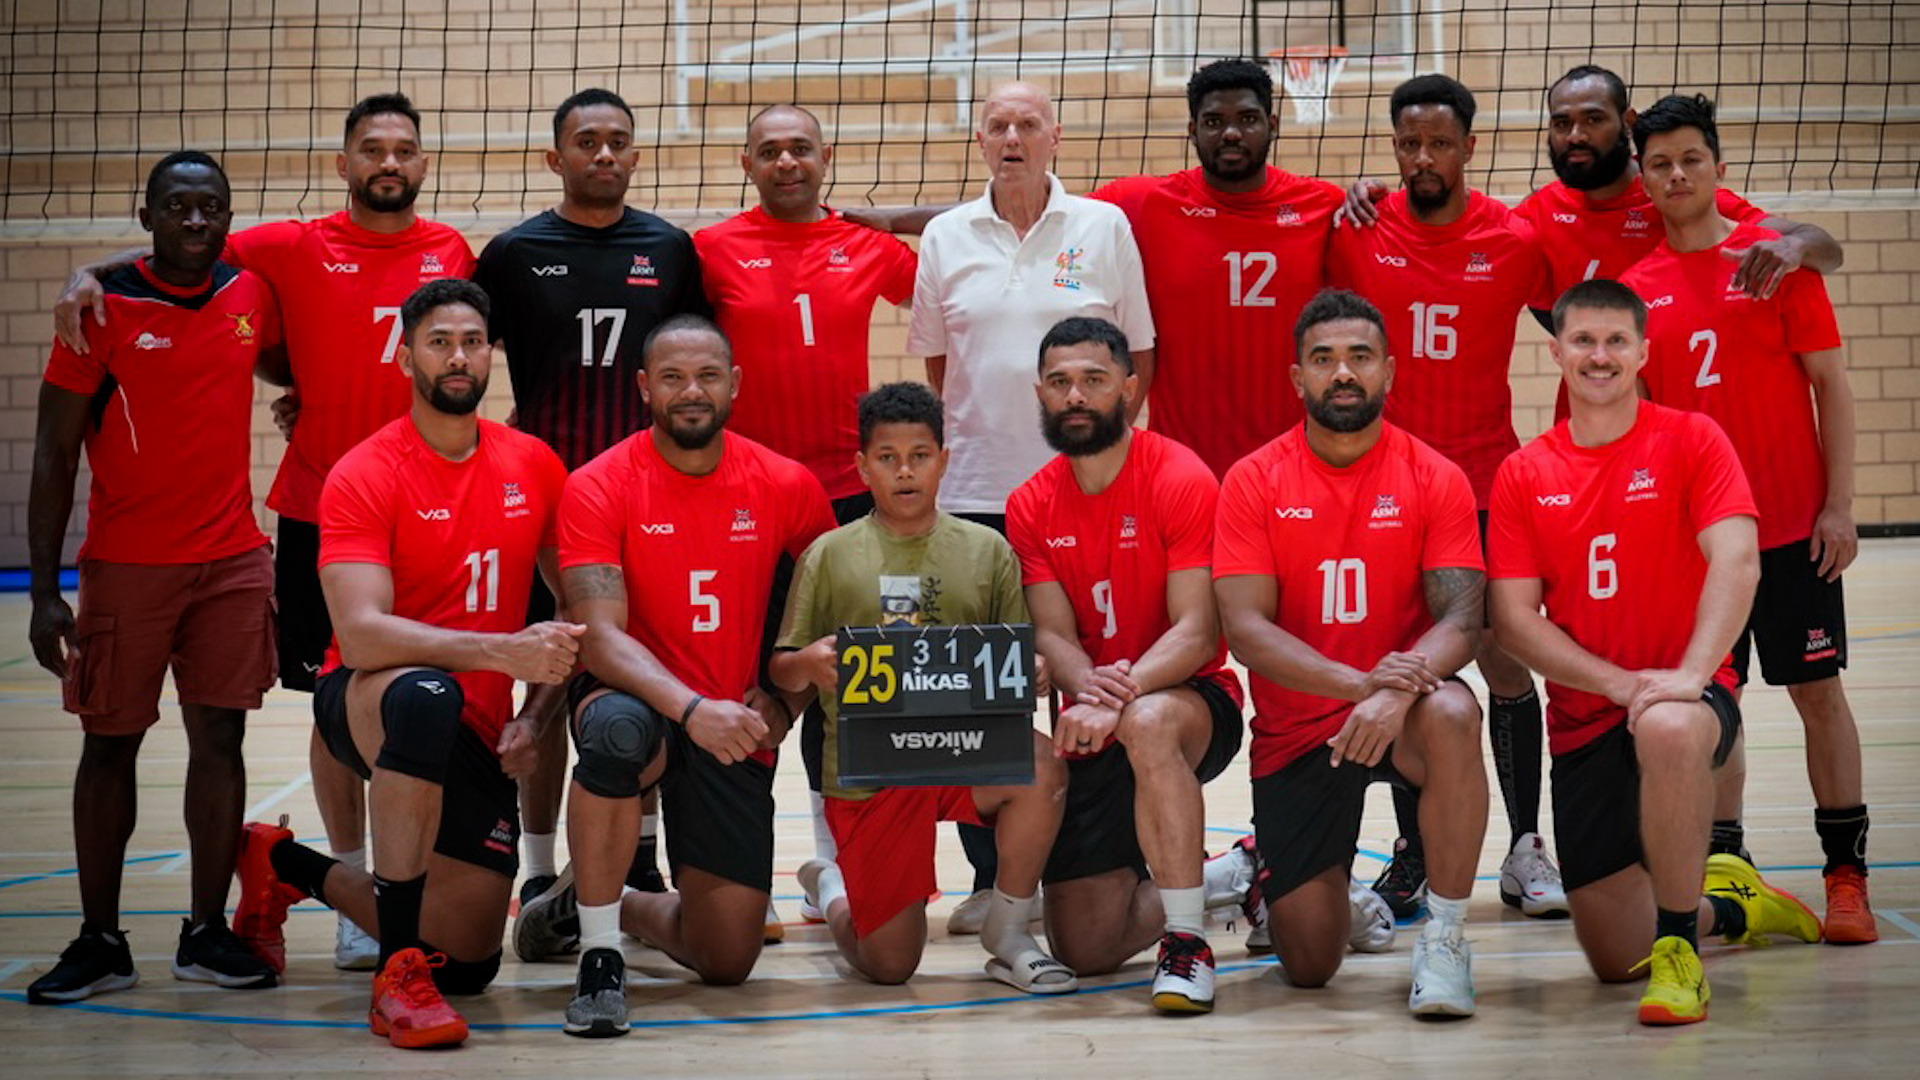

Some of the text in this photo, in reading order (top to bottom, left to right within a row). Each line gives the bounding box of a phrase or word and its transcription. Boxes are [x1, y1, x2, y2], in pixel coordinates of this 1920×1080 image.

[1180, 206, 1217, 218] VX3
[1623, 220, 1650, 230] ARMY
[322, 261, 359, 273] VX3
[737, 258, 773, 269] VX3
[1375, 253, 1407, 268] VX3
[1465, 263, 1494, 273] ARMY
[531, 265, 569, 277] VX3
[630, 266, 656, 277] ARMY
[1222, 252, 1278, 307] 12
[793, 293, 816, 347] 1
[373, 306, 405, 364] 7
[576, 308, 628, 367] 17
[1408, 302, 1460, 360] 16
[1689, 328, 1721, 389] 2
[1626, 477, 1657, 493] ARMY
[1536, 494, 1573, 507] VX3
[416, 508, 451, 521] VX3
[1275, 507, 1314, 519] VX3
[1371, 506, 1402, 519] ARMY
[640, 524, 674, 535] VX3
[731, 521, 757, 532] ARMY
[1046, 535, 1077, 548] VX3
[1588, 533, 1618, 600] 6
[464, 548, 500, 613] 11
[1317, 558, 1368, 624] 10
[689, 570, 722, 632] 5
[1092, 579, 1118, 639] 9
[944, 637, 959, 664] 1
[1806, 636, 1834, 651] ARMY
[912, 639, 931, 666] 3
[842, 644, 898, 705] 25
[974, 640, 1029, 701] 14
